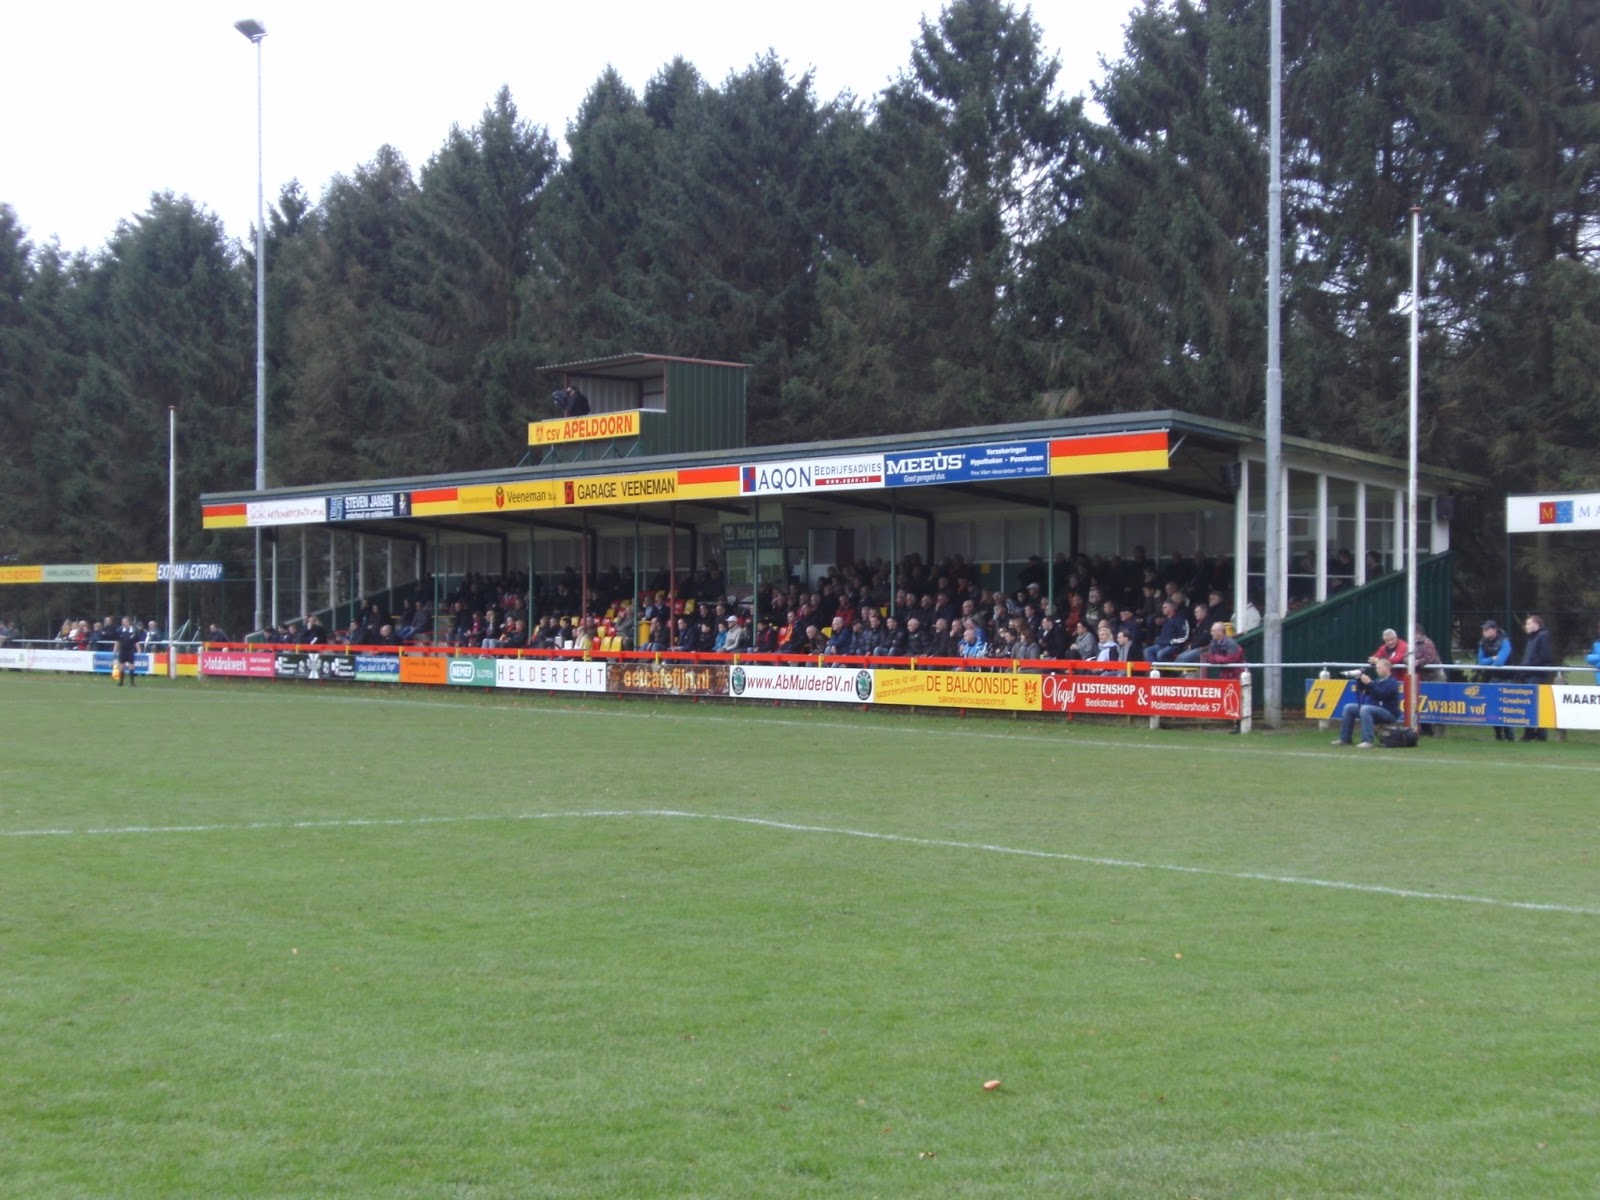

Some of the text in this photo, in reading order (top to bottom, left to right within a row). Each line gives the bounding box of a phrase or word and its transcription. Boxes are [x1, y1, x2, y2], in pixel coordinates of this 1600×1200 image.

[563, 415, 633, 439] APELDOORN
[758, 466, 811, 491] AQON
[814, 463, 882, 476] BEDRIJFSADVIES
[507, 491, 546, 504] Veeneman
[577, 478, 675, 499] GARAGE VEENEMAN
[345, 496, 368, 509] STEVEN
[370, 494, 393, 507] JANSEN
[158, 564, 184, 579] EXTAN
[190, 564, 218, 579] EXTRAN
[452, 666, 472, 677] NEMEF
[497, 664, 603, 685] HELDERECHT
[747, 674, 854, 692] www.AbMulderBV.nl
[926, 675, 1018, 695] DE BALKONSIDE
[1042, 675, 1221, 711] Vogel LIJSTENSHOP & KUNSTUITLEEN
[1085, 698, 1119, 708] Beekstraat
[1151, 701, 1221, 712] Molenmakershoek 57
[1419, 695, 1466, 714] Zwaan
